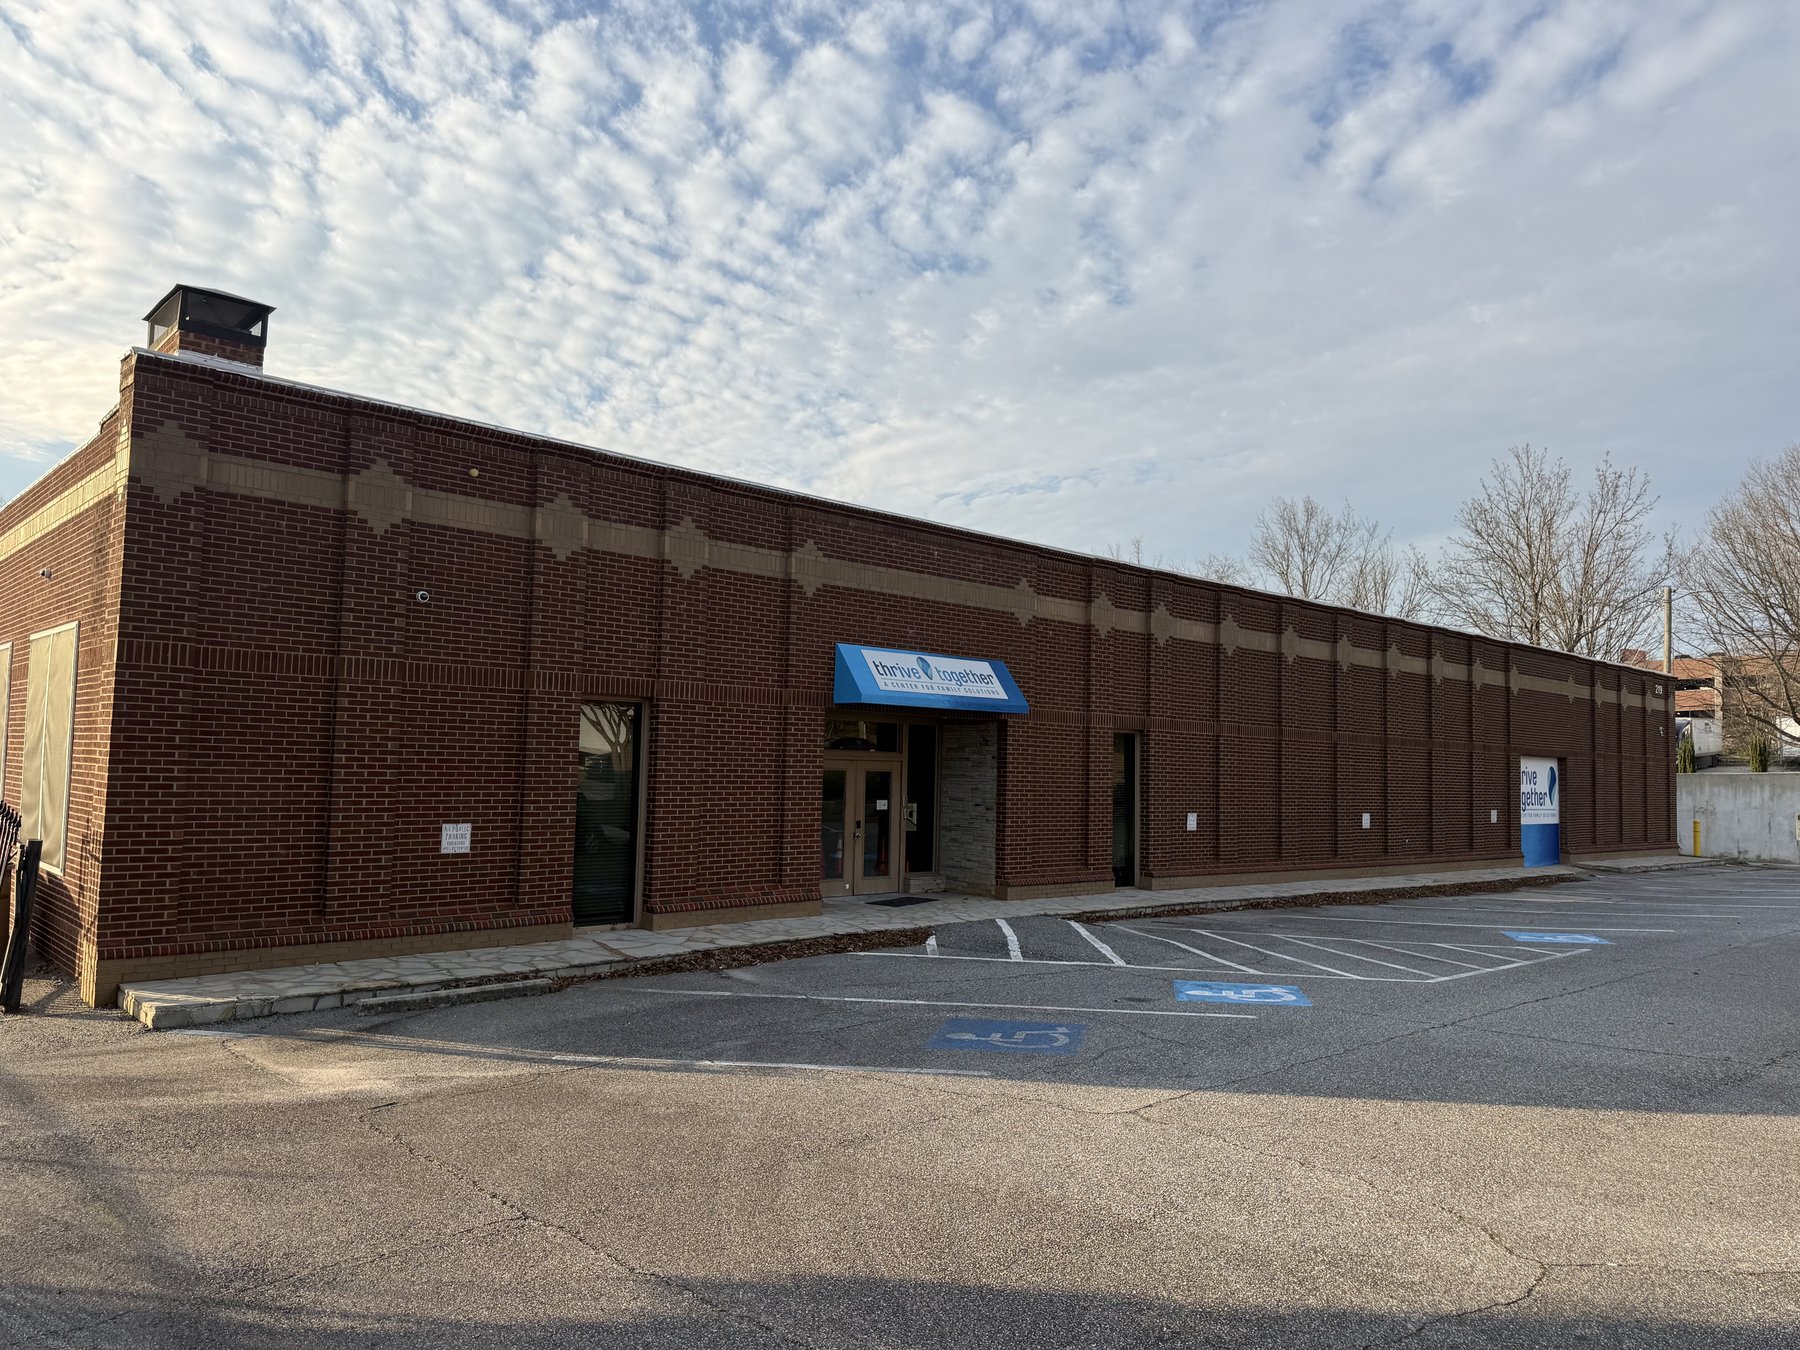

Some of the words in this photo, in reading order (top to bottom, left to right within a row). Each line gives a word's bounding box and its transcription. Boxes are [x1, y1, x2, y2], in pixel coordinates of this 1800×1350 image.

[872, 660, 920, 680] thrive
[934, 666, 994, 687] together
[891, 682, 919, 690] CENTER
[921, 683, 934, 691] FOR
[937, 685, 962, 693] FAMILY
[964, 687, 1000, 696] SOLUTIONS
[1521, 766, 1538, 786] rive
[1521, 787, 1548, 812] gether
